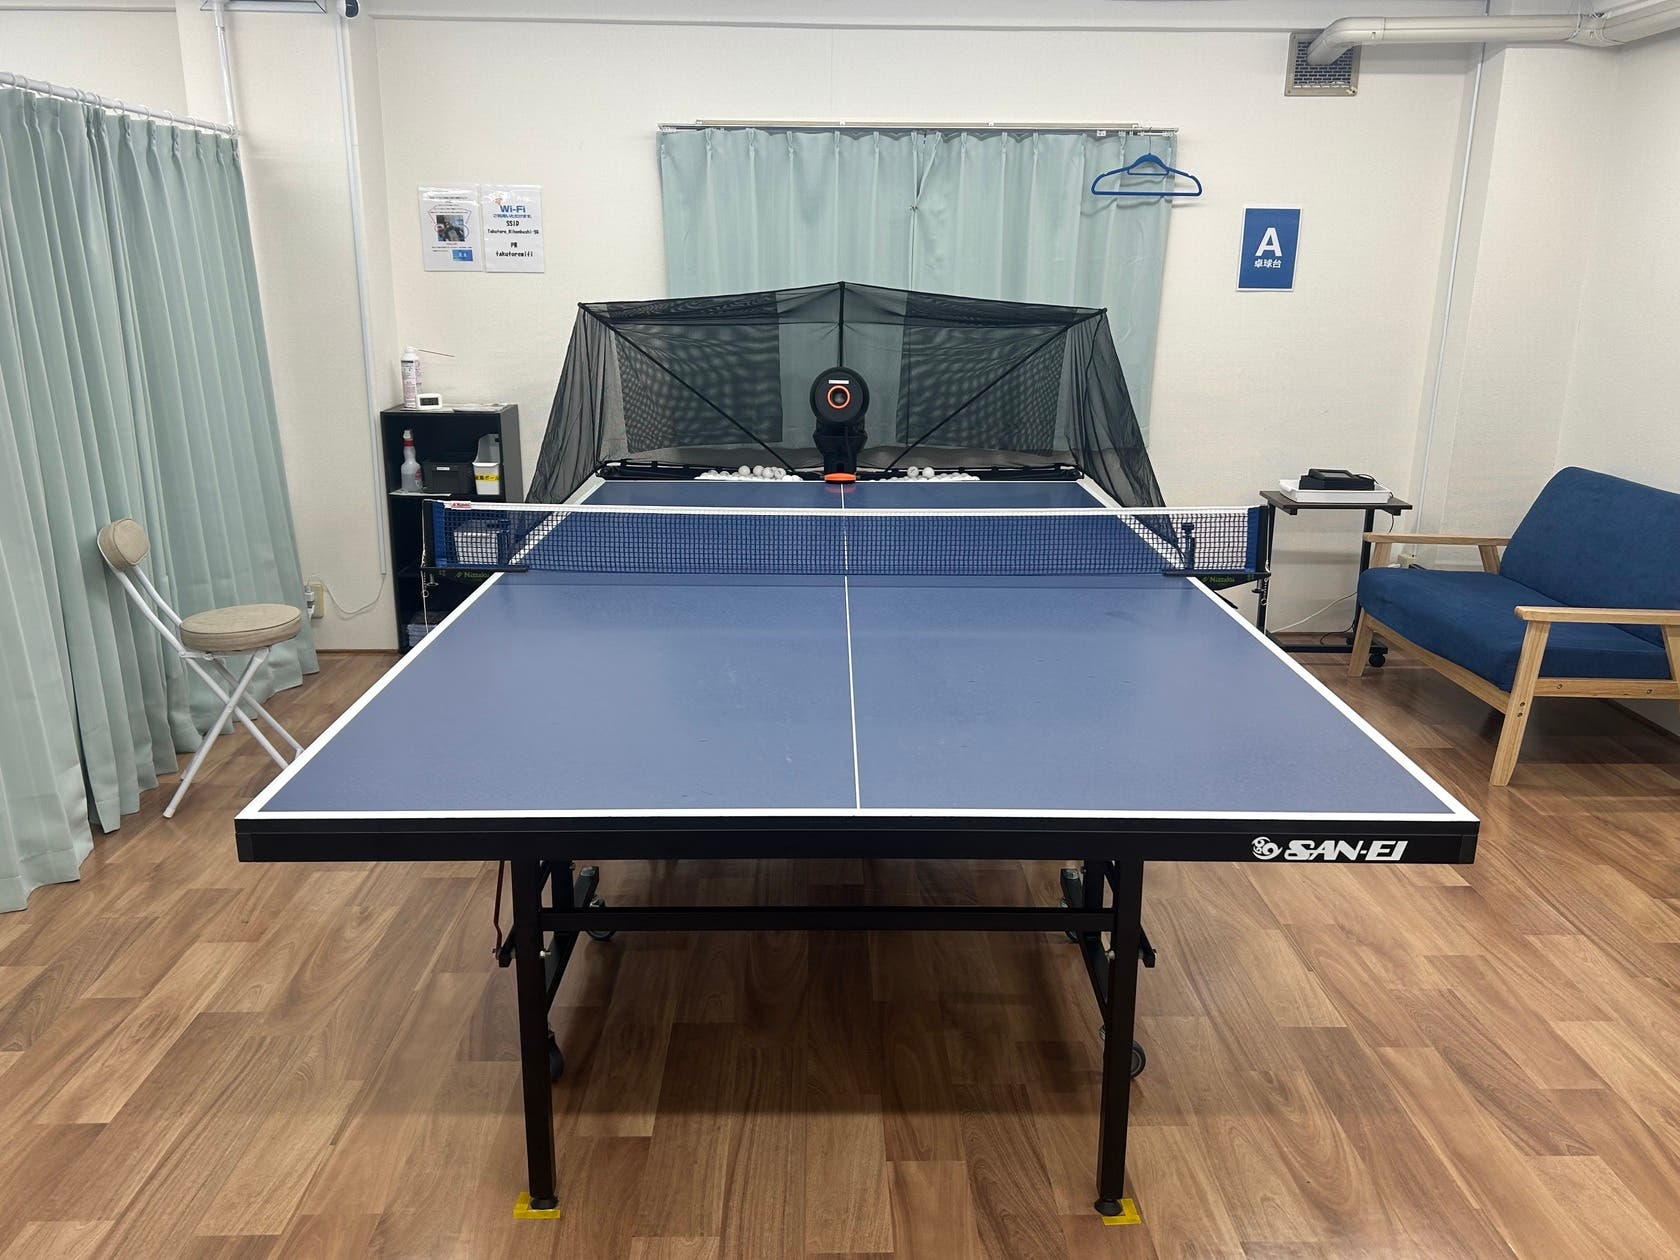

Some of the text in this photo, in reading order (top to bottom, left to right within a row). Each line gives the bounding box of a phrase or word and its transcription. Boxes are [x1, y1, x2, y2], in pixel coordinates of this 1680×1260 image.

[500, 205, 526, 213] Wi-Fi
[1255, 227, 1282, 257] A
[1254, 258, 1282, 269] 卓球台
[1284, 840, 1408, 861] SAN-EI
